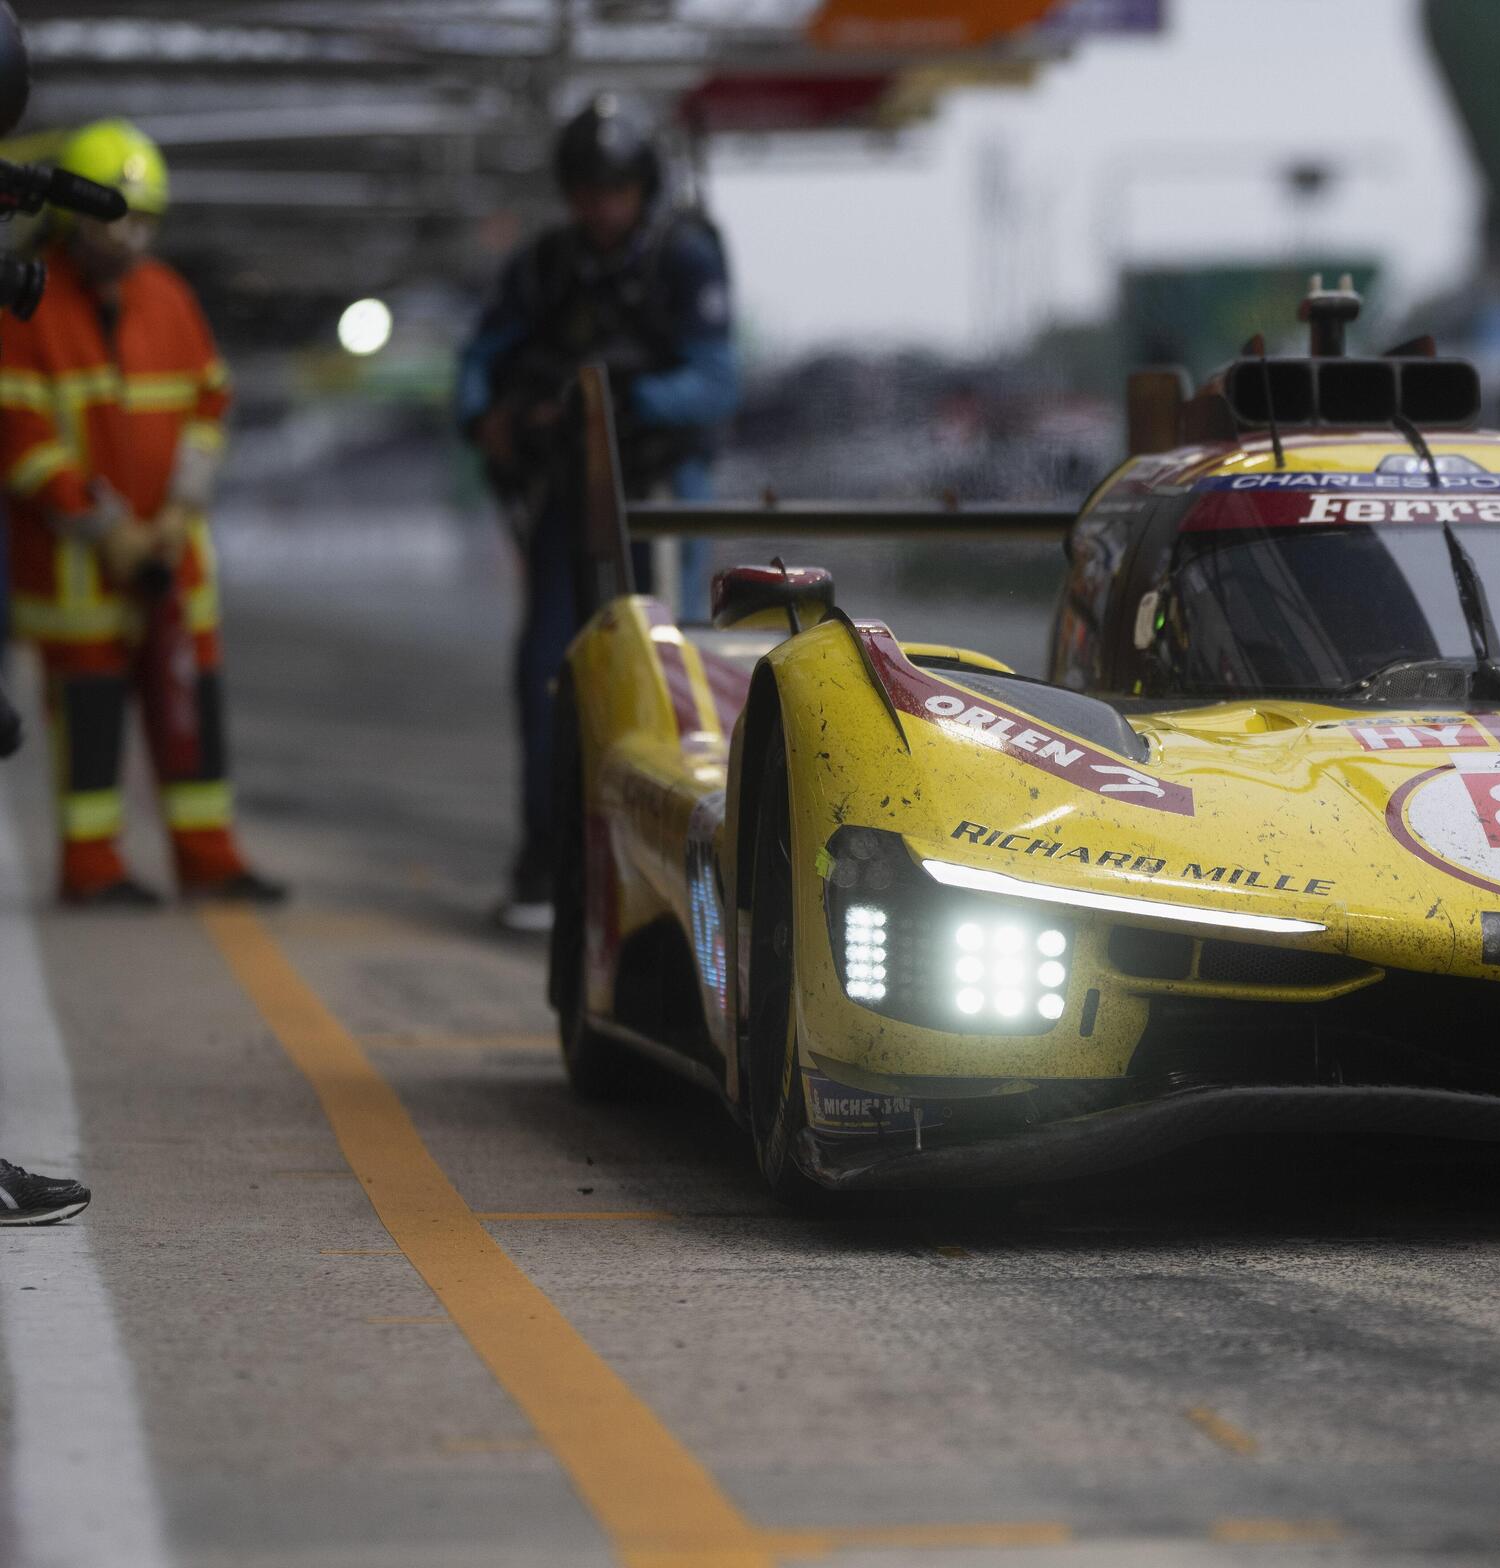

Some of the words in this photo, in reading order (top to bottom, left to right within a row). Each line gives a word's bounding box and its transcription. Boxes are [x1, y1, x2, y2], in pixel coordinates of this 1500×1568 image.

[1231, 473, 1430, 489] CHARLES
[923, 695, 1085, 768] ORLEN
[1356, 725, 1464, 750] HY
[950, 819, 1168, 874] RICHARD
[1180, 863, 1337, 897] MILLE
